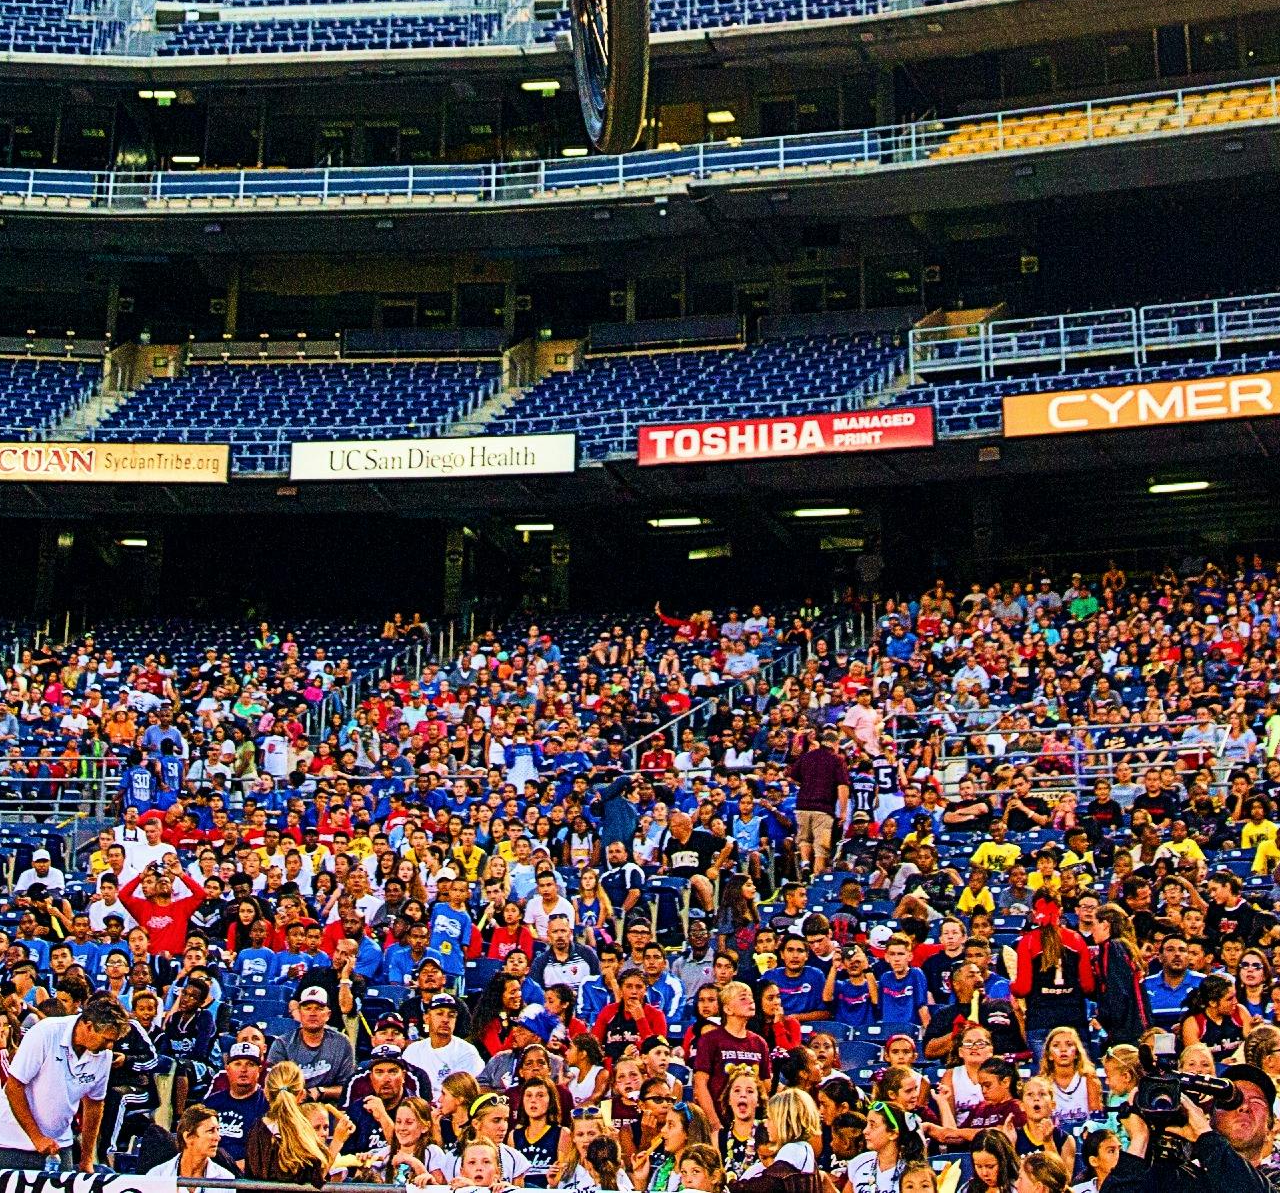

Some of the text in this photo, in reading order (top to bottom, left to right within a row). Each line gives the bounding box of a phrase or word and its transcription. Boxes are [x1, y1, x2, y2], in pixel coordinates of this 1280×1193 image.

[1048, 378, 1273, 429] CYMER
[833, 412, 915, 430] MANAGED
[649, 420, 825, 459] TOSHIBA
[833, 430, 883, 447] PRINT
[104, 452, 220, 474] SycuanTribe.org
[329, 446, 535, 473] UC San Diego Health
[132, 773, 150, 789] 30
[878, 768, 891, 788] 5
[242, 1043, 250, 1054] P
